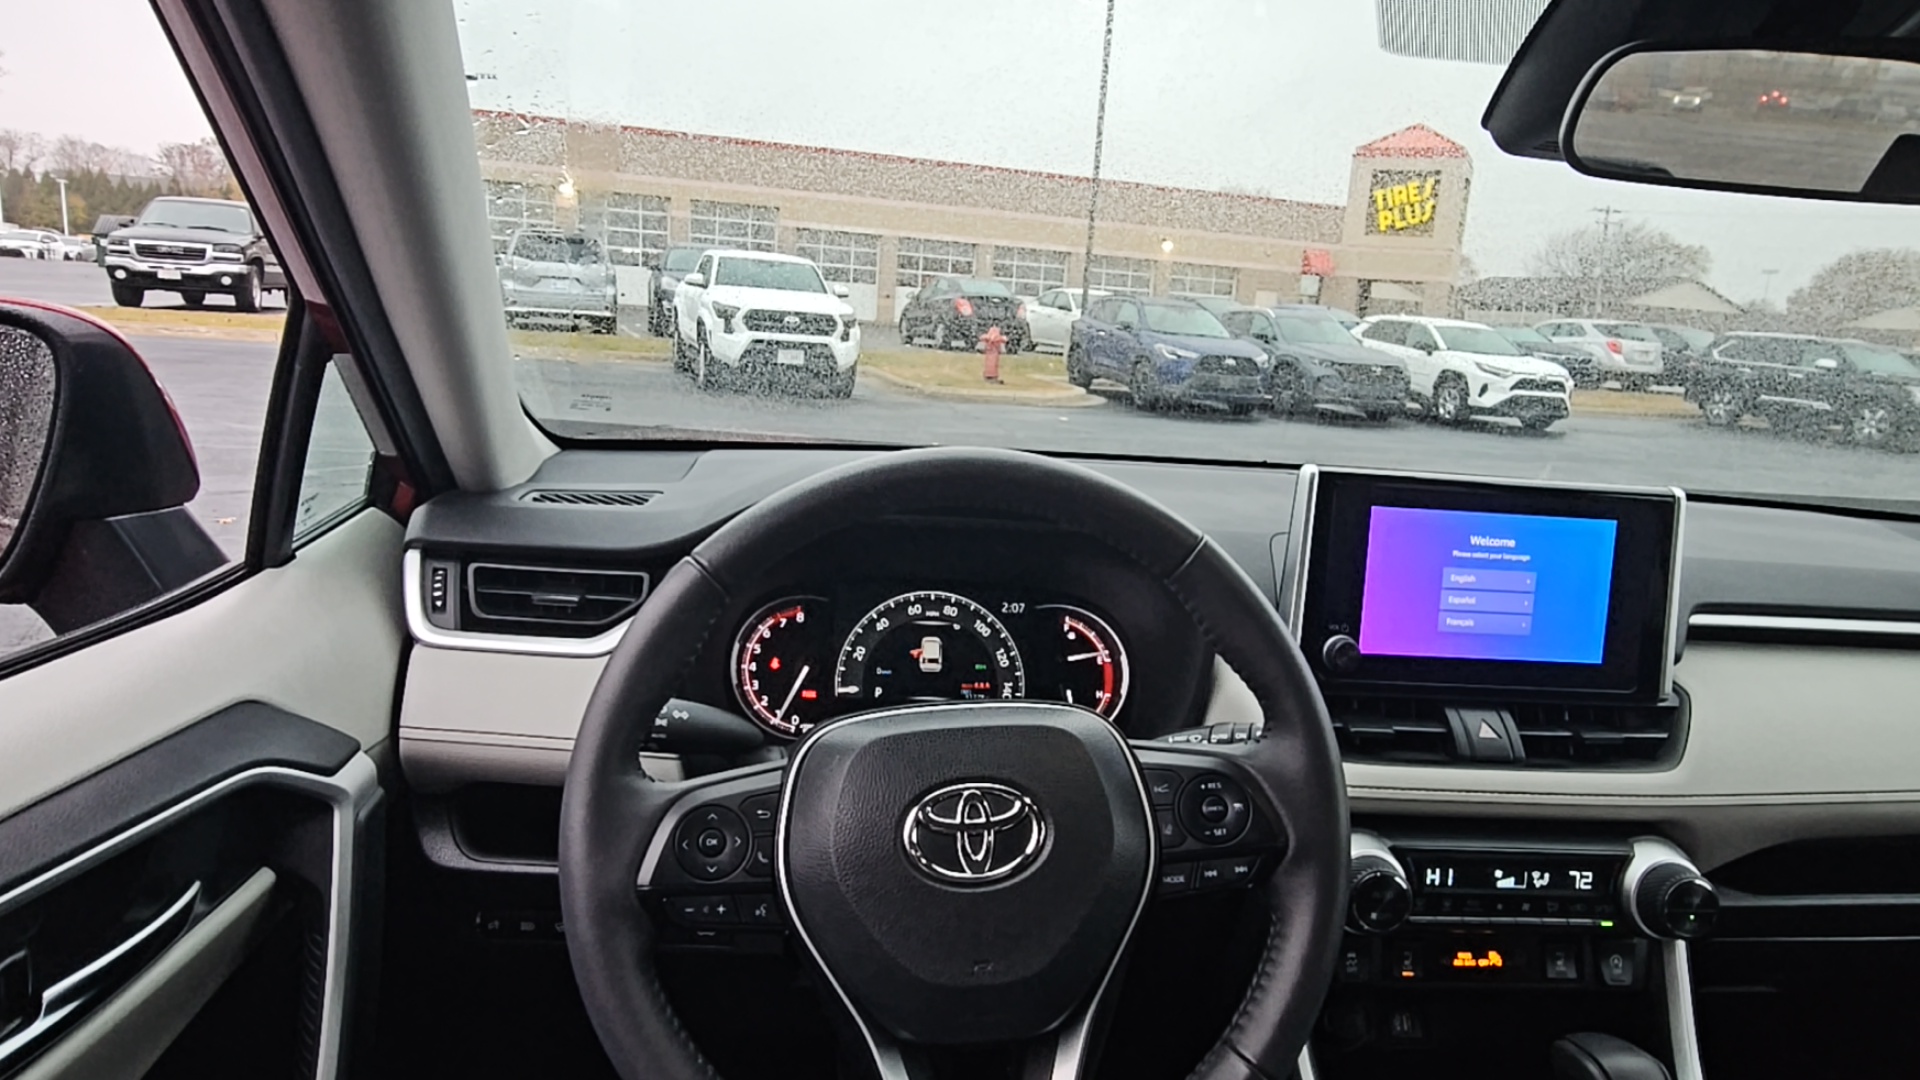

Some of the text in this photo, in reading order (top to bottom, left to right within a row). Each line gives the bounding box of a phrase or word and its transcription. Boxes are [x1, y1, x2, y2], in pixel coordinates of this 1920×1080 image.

[1373, 176, 1436, 211] TIRES
[1377, 199, 1436, 233] PLUS
[1470, 535, 1516, 548] Welcome
[1450, 574, 1476, 584] English
[1448, 595, 1476, 605] Español
[907, 604, 922, 616] 60
[943, 605, 958, 617] 80
[1001, 602, 1025, 613] 2:07
[779, 617, 787, 628] 7
[796, 611, 805, 623] 8
[1446, 617, 1475, 628] Français
[875, 617, 890, 632] 40
[973, 619, 991, 637] 100
[762, 627, 771, 638] 6
[753, 643, 762, 655] 5
[852, 646, 866, 661] 20
[995, 647, 1009, 668] 120
[748, 661, 757, 672] 4
[751, 680, 760, 690] 3
[874, 686, 883, 698] P
[760, 695, 769, 706] 2
[791, 714, 800, 725] 0
[1213, 828, 1227, 836] SET
[706, 838, 718, 846] OK
[1162, 875, 1186, 884] MODE
[1568, 870, 1593, 889] 72
